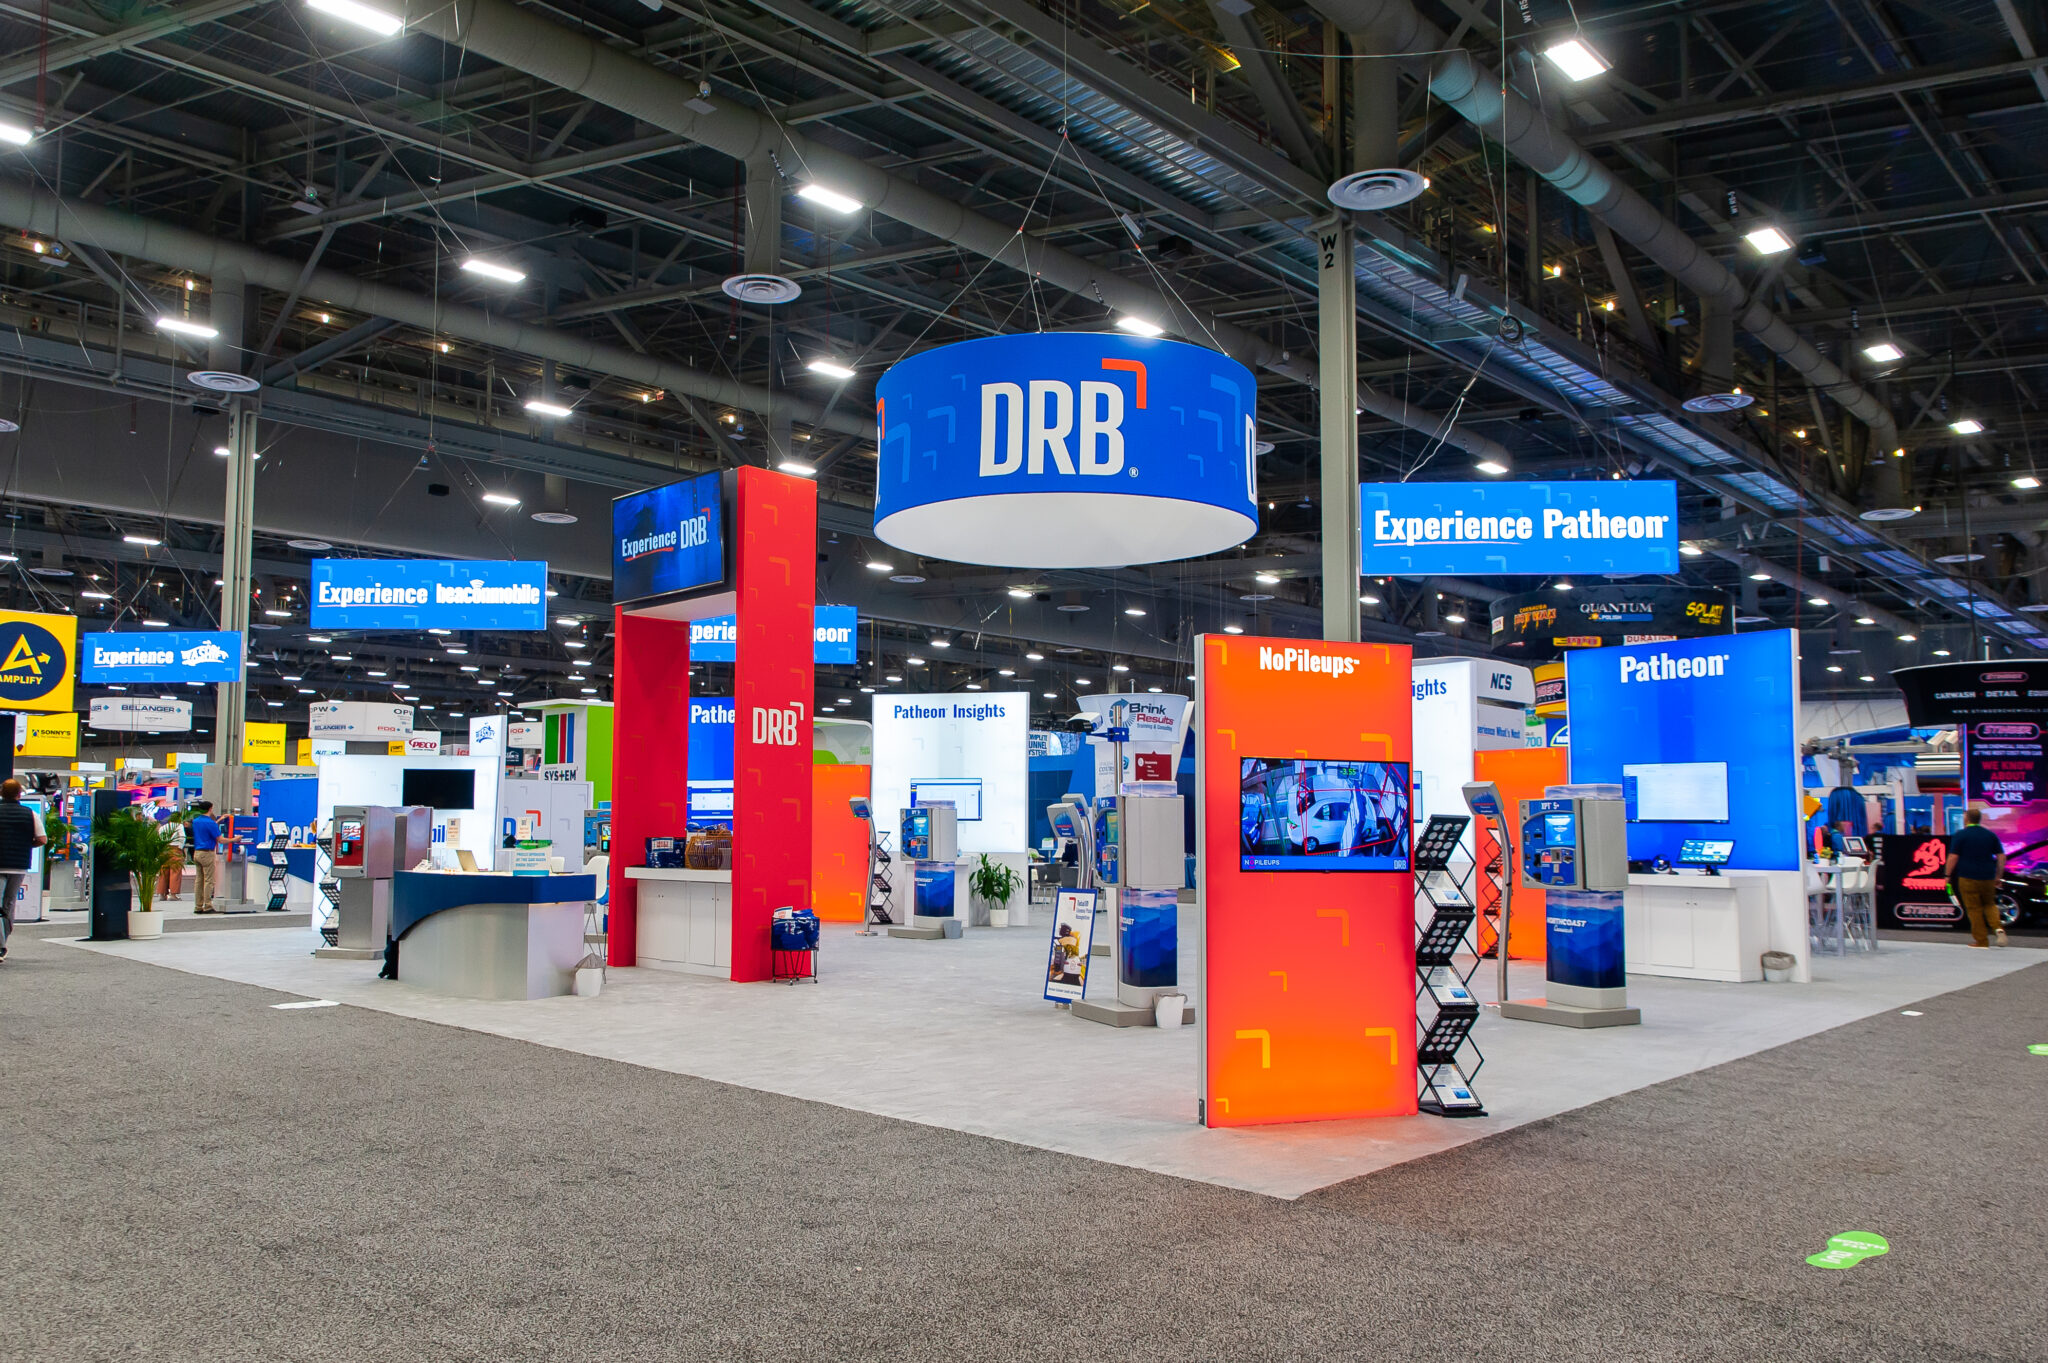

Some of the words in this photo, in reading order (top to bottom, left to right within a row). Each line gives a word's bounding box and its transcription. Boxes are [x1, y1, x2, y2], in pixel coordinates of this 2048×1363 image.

[1375, 509, 1532, 546] Experience
[1543, 508, 1668, 540] Patheon
[622, 530, 677, 559] Experience
[680, 515, 709, 550] DRB
[319, 581, 428, 607] Experience
[436, 581, 540, 605] beaconmobile
[1580, 602, 1654, 613] QUANTUM
[94, 647, 174, 668] Experience
[1260, 647, 1359, 678] NoPileups
[1620, 653, 1728, 684] Patheon
[0, 674, 43, 685] AMPLIFY
[1490, 672, 1512, 690] NCS
[121, 704, 175, 713] BELANGER
[894, 704, 948, 719] Patheon
[953, 703, 1006, 721] Insights
[1129, 702, 1167, 715] Brink
[1136, 713, 1175, 725] Results
[752, 706, 798, 746] DRB
[1525, 736, 1543, 747] 700
[1990, 771, 2026, 780] ABOUT
[1982, 781, 2034, 791] WASHING
[1994, 791, 2024, 801] CARS
[1244, 858, 1280, 866] NOPILEUPS
[1393, 859, 1407, 869] DRB
